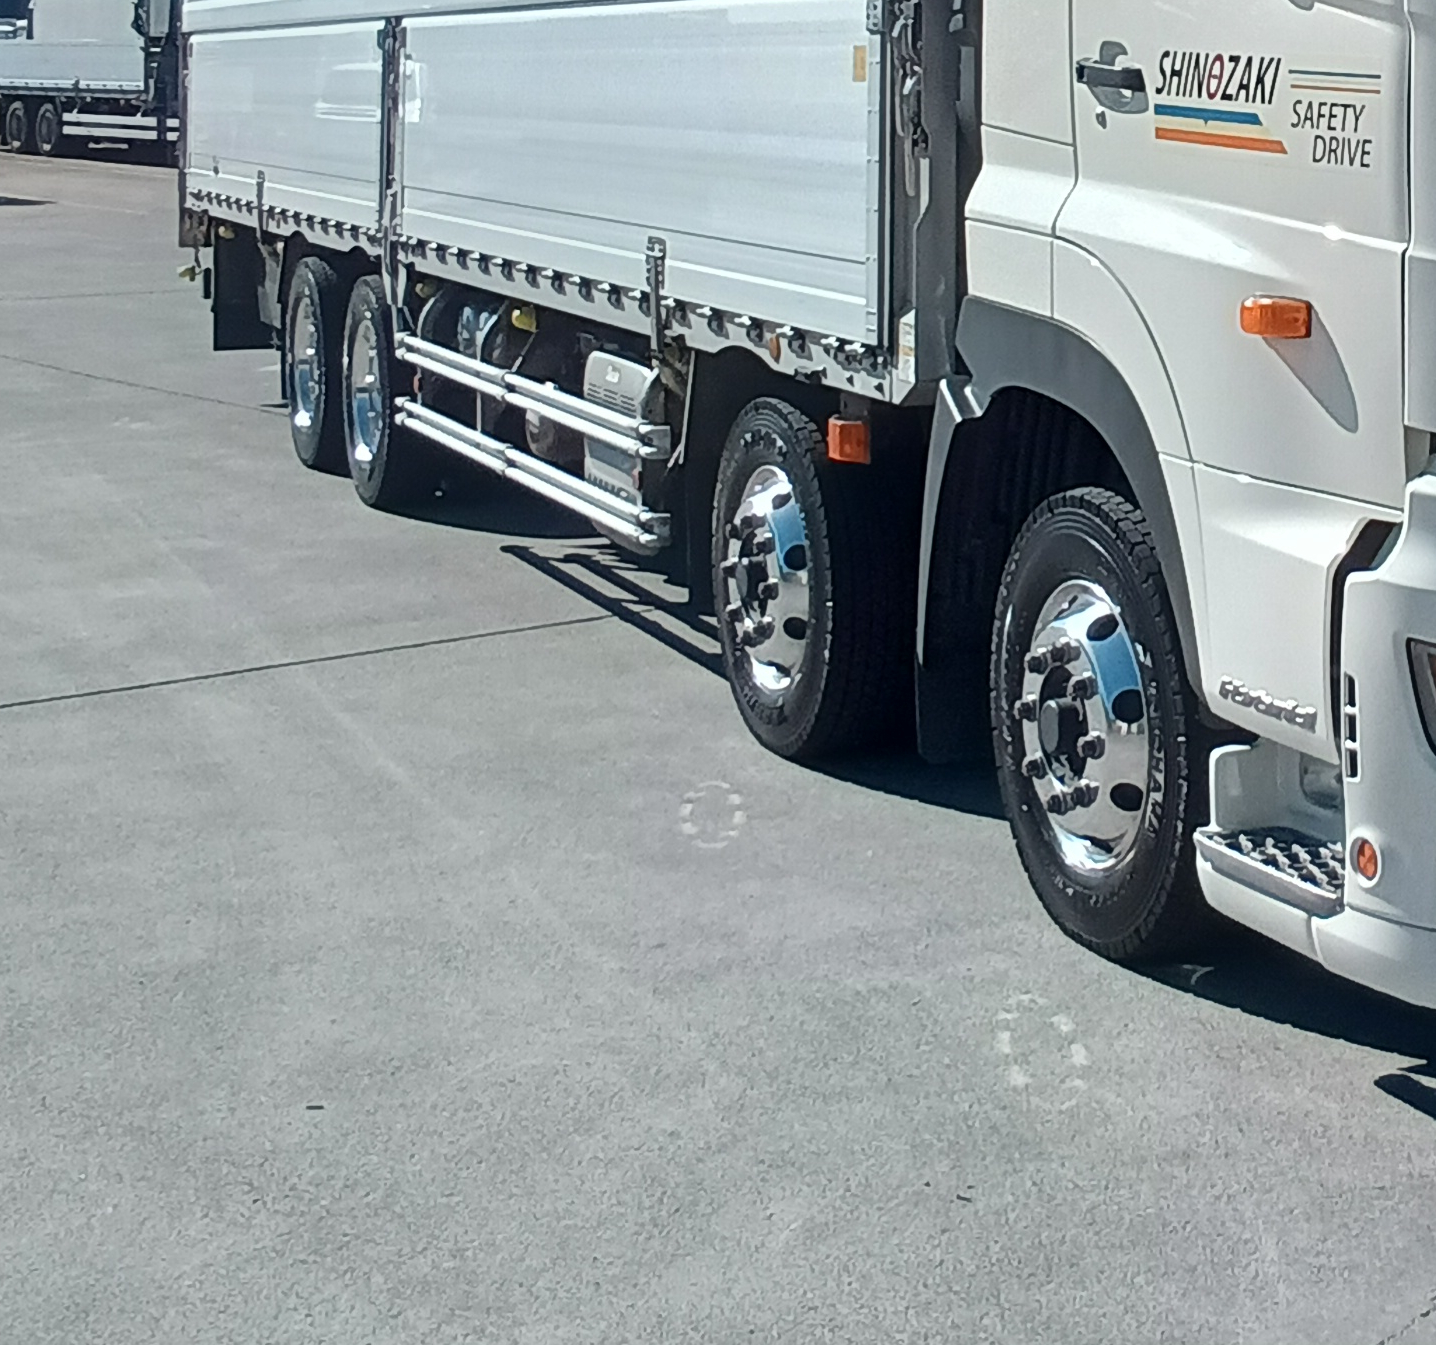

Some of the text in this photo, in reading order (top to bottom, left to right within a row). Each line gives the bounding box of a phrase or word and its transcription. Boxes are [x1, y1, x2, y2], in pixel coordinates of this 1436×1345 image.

[1154, 50, 1282, 105] SHINOZAKI
[1290, 99, 1366, 134] SAFETY
[1311, 135, 1374, 169] DRIVE
